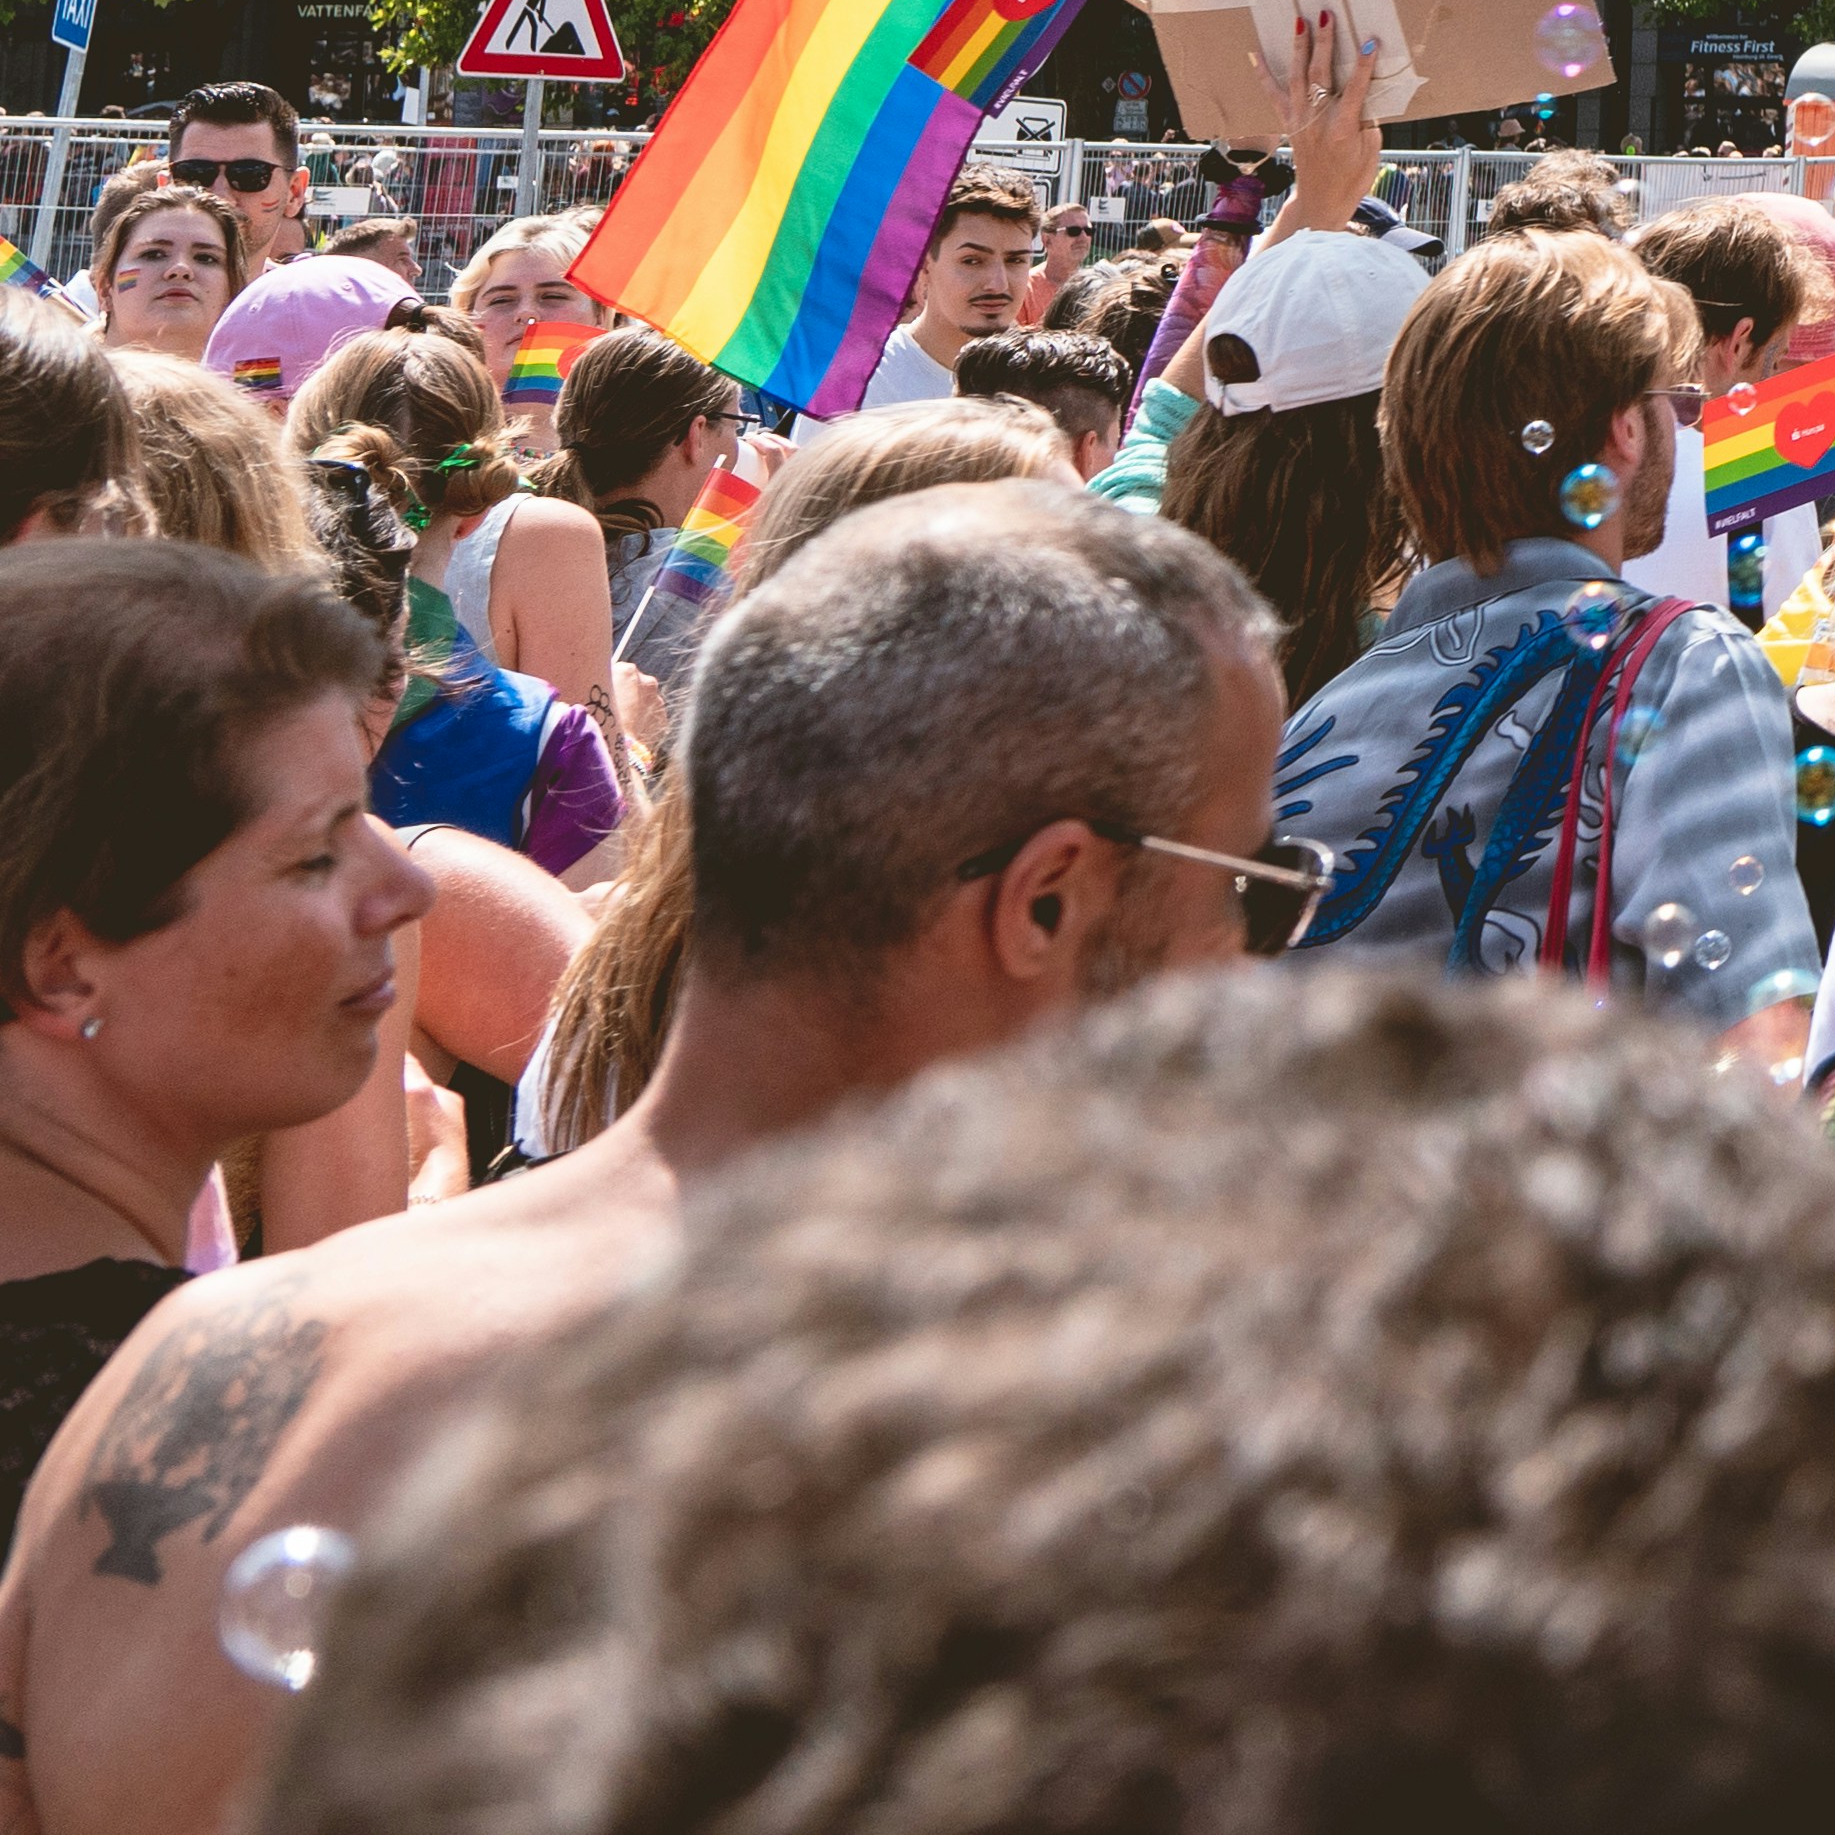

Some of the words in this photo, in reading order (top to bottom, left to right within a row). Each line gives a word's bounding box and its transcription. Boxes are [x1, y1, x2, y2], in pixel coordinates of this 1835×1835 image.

[1690, 40, 1740, 54] Fitness
[1743, 40, 1775, 53] First
[1714, 507, 1757, 530] #VIELFALT
